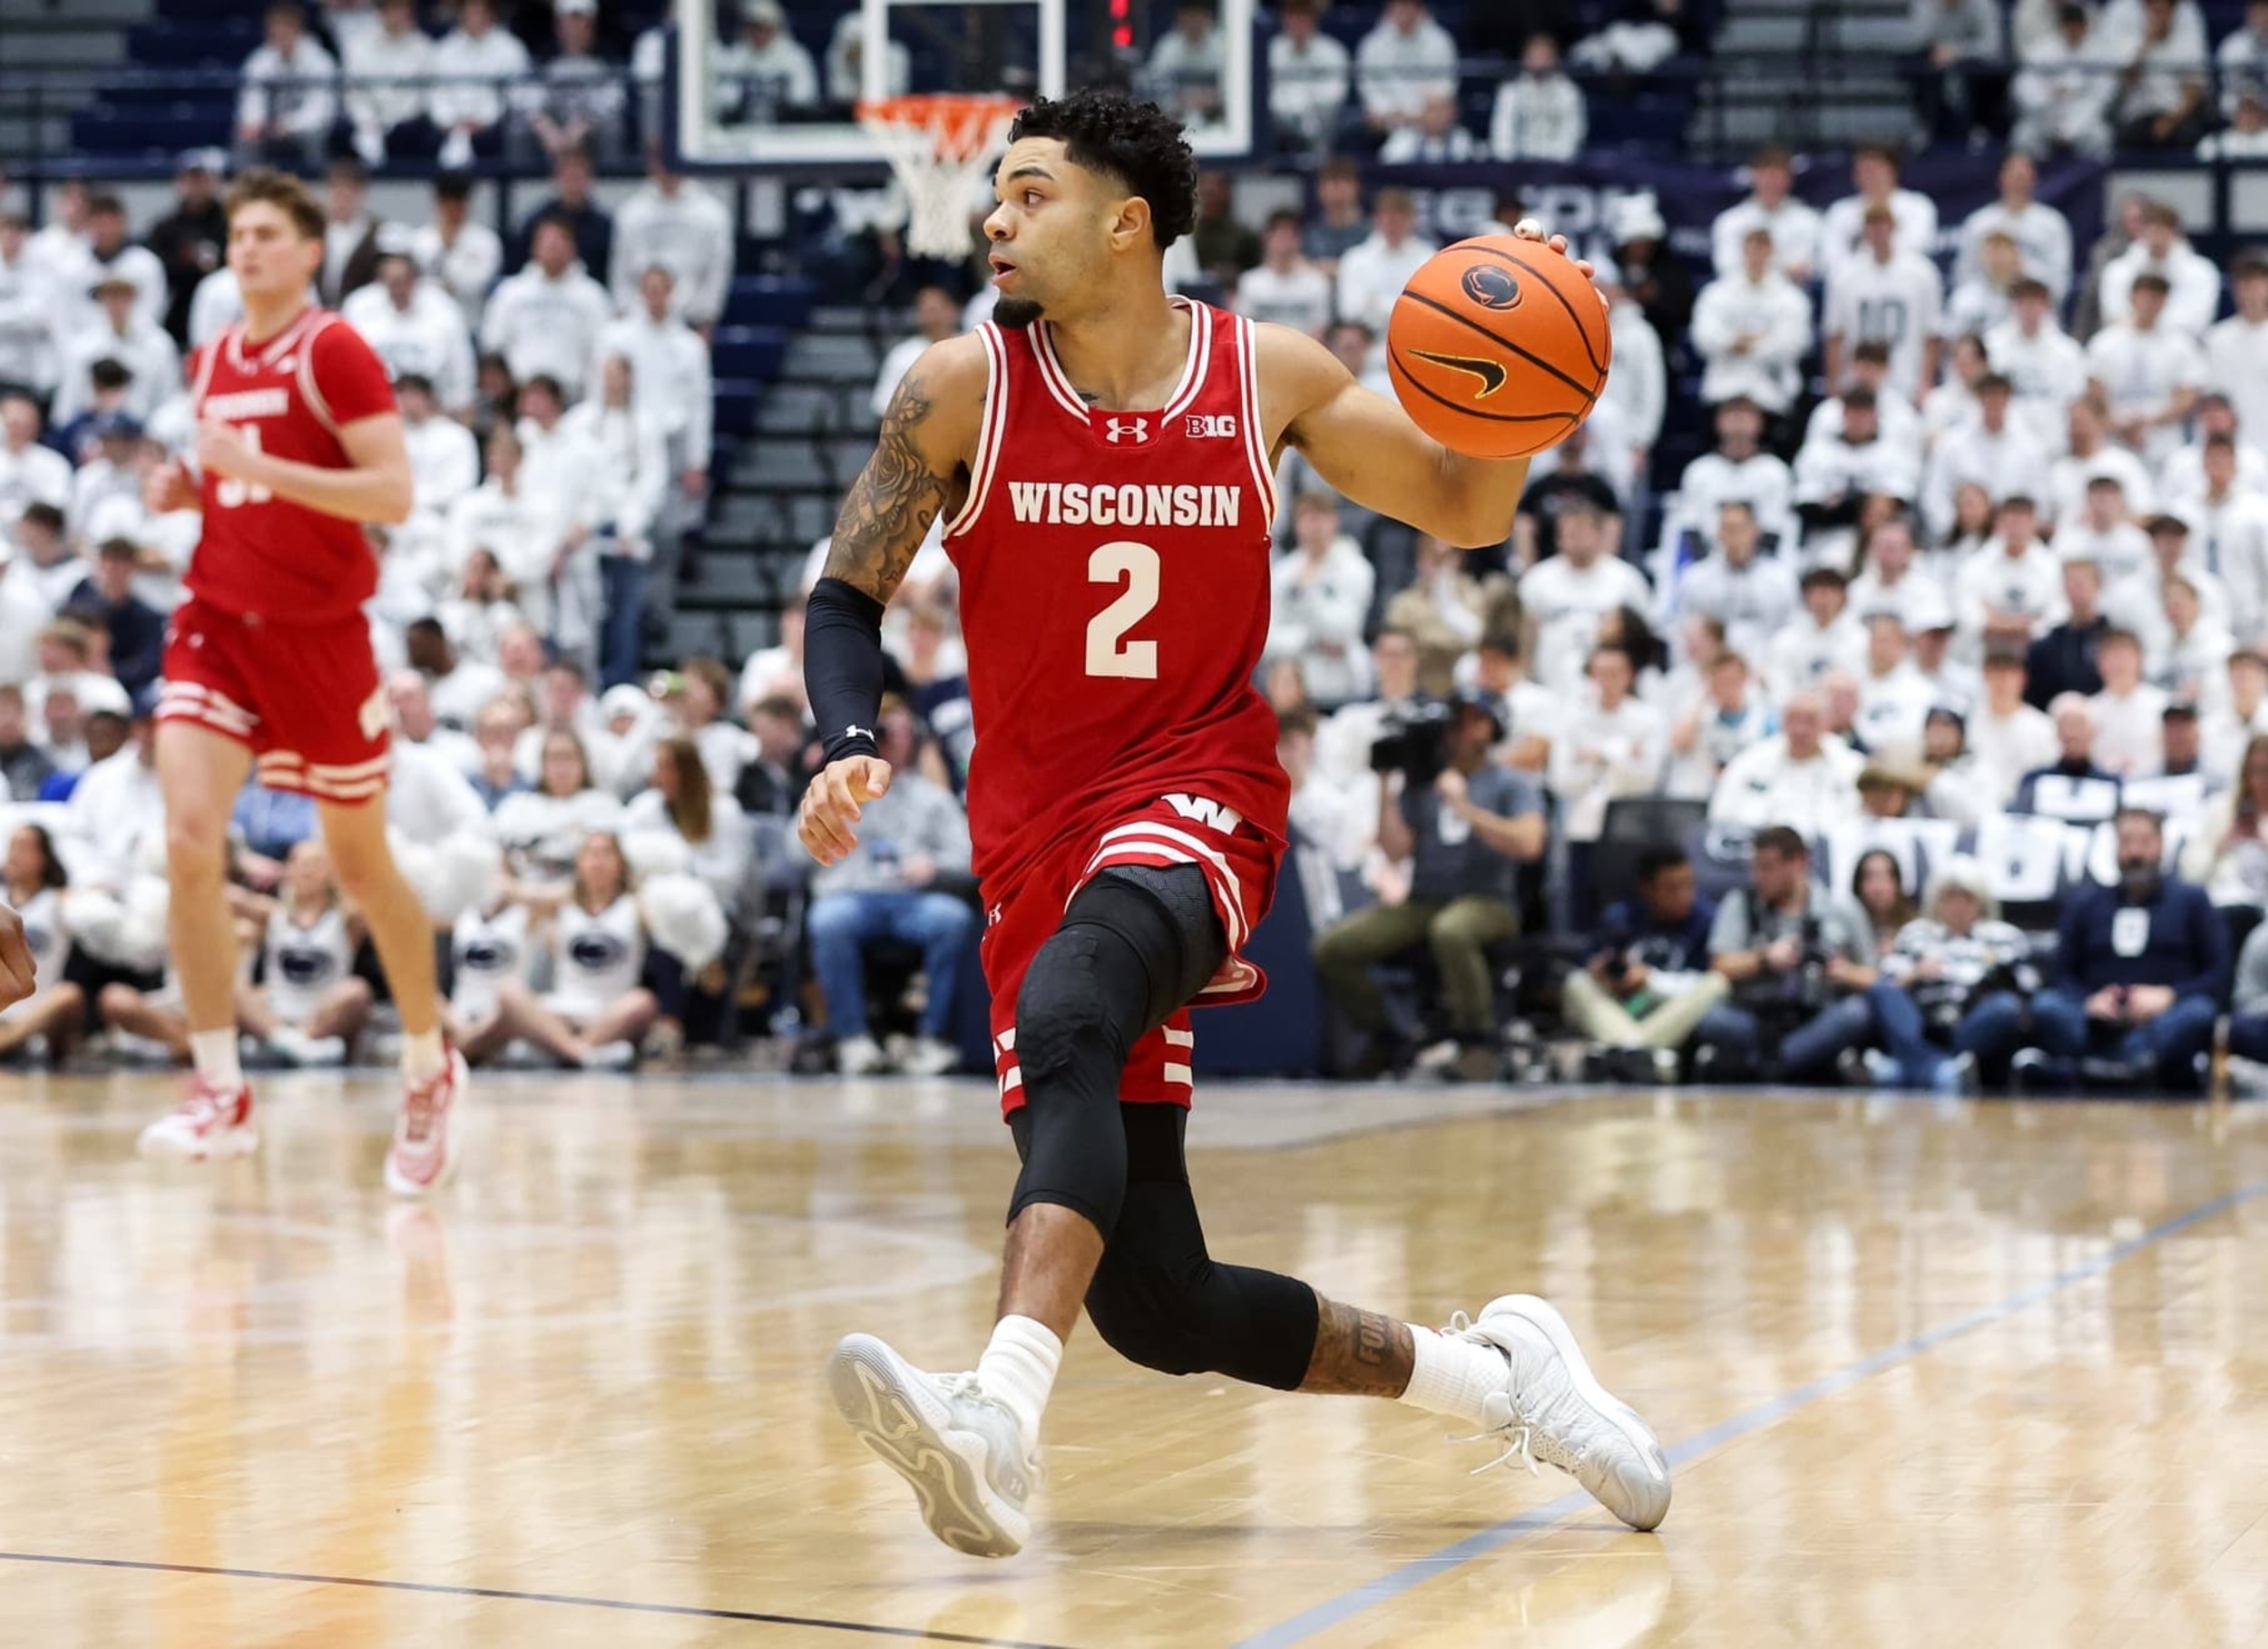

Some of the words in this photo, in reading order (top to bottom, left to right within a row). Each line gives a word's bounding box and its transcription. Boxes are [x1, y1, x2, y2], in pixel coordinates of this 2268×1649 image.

[1186, 415, 1237, 437] BIG
[1008, 482, 1241, 526] WISCONSIN
[1085, 541, 1160, 679] 2
[1160, 793, 1243, 835] W
